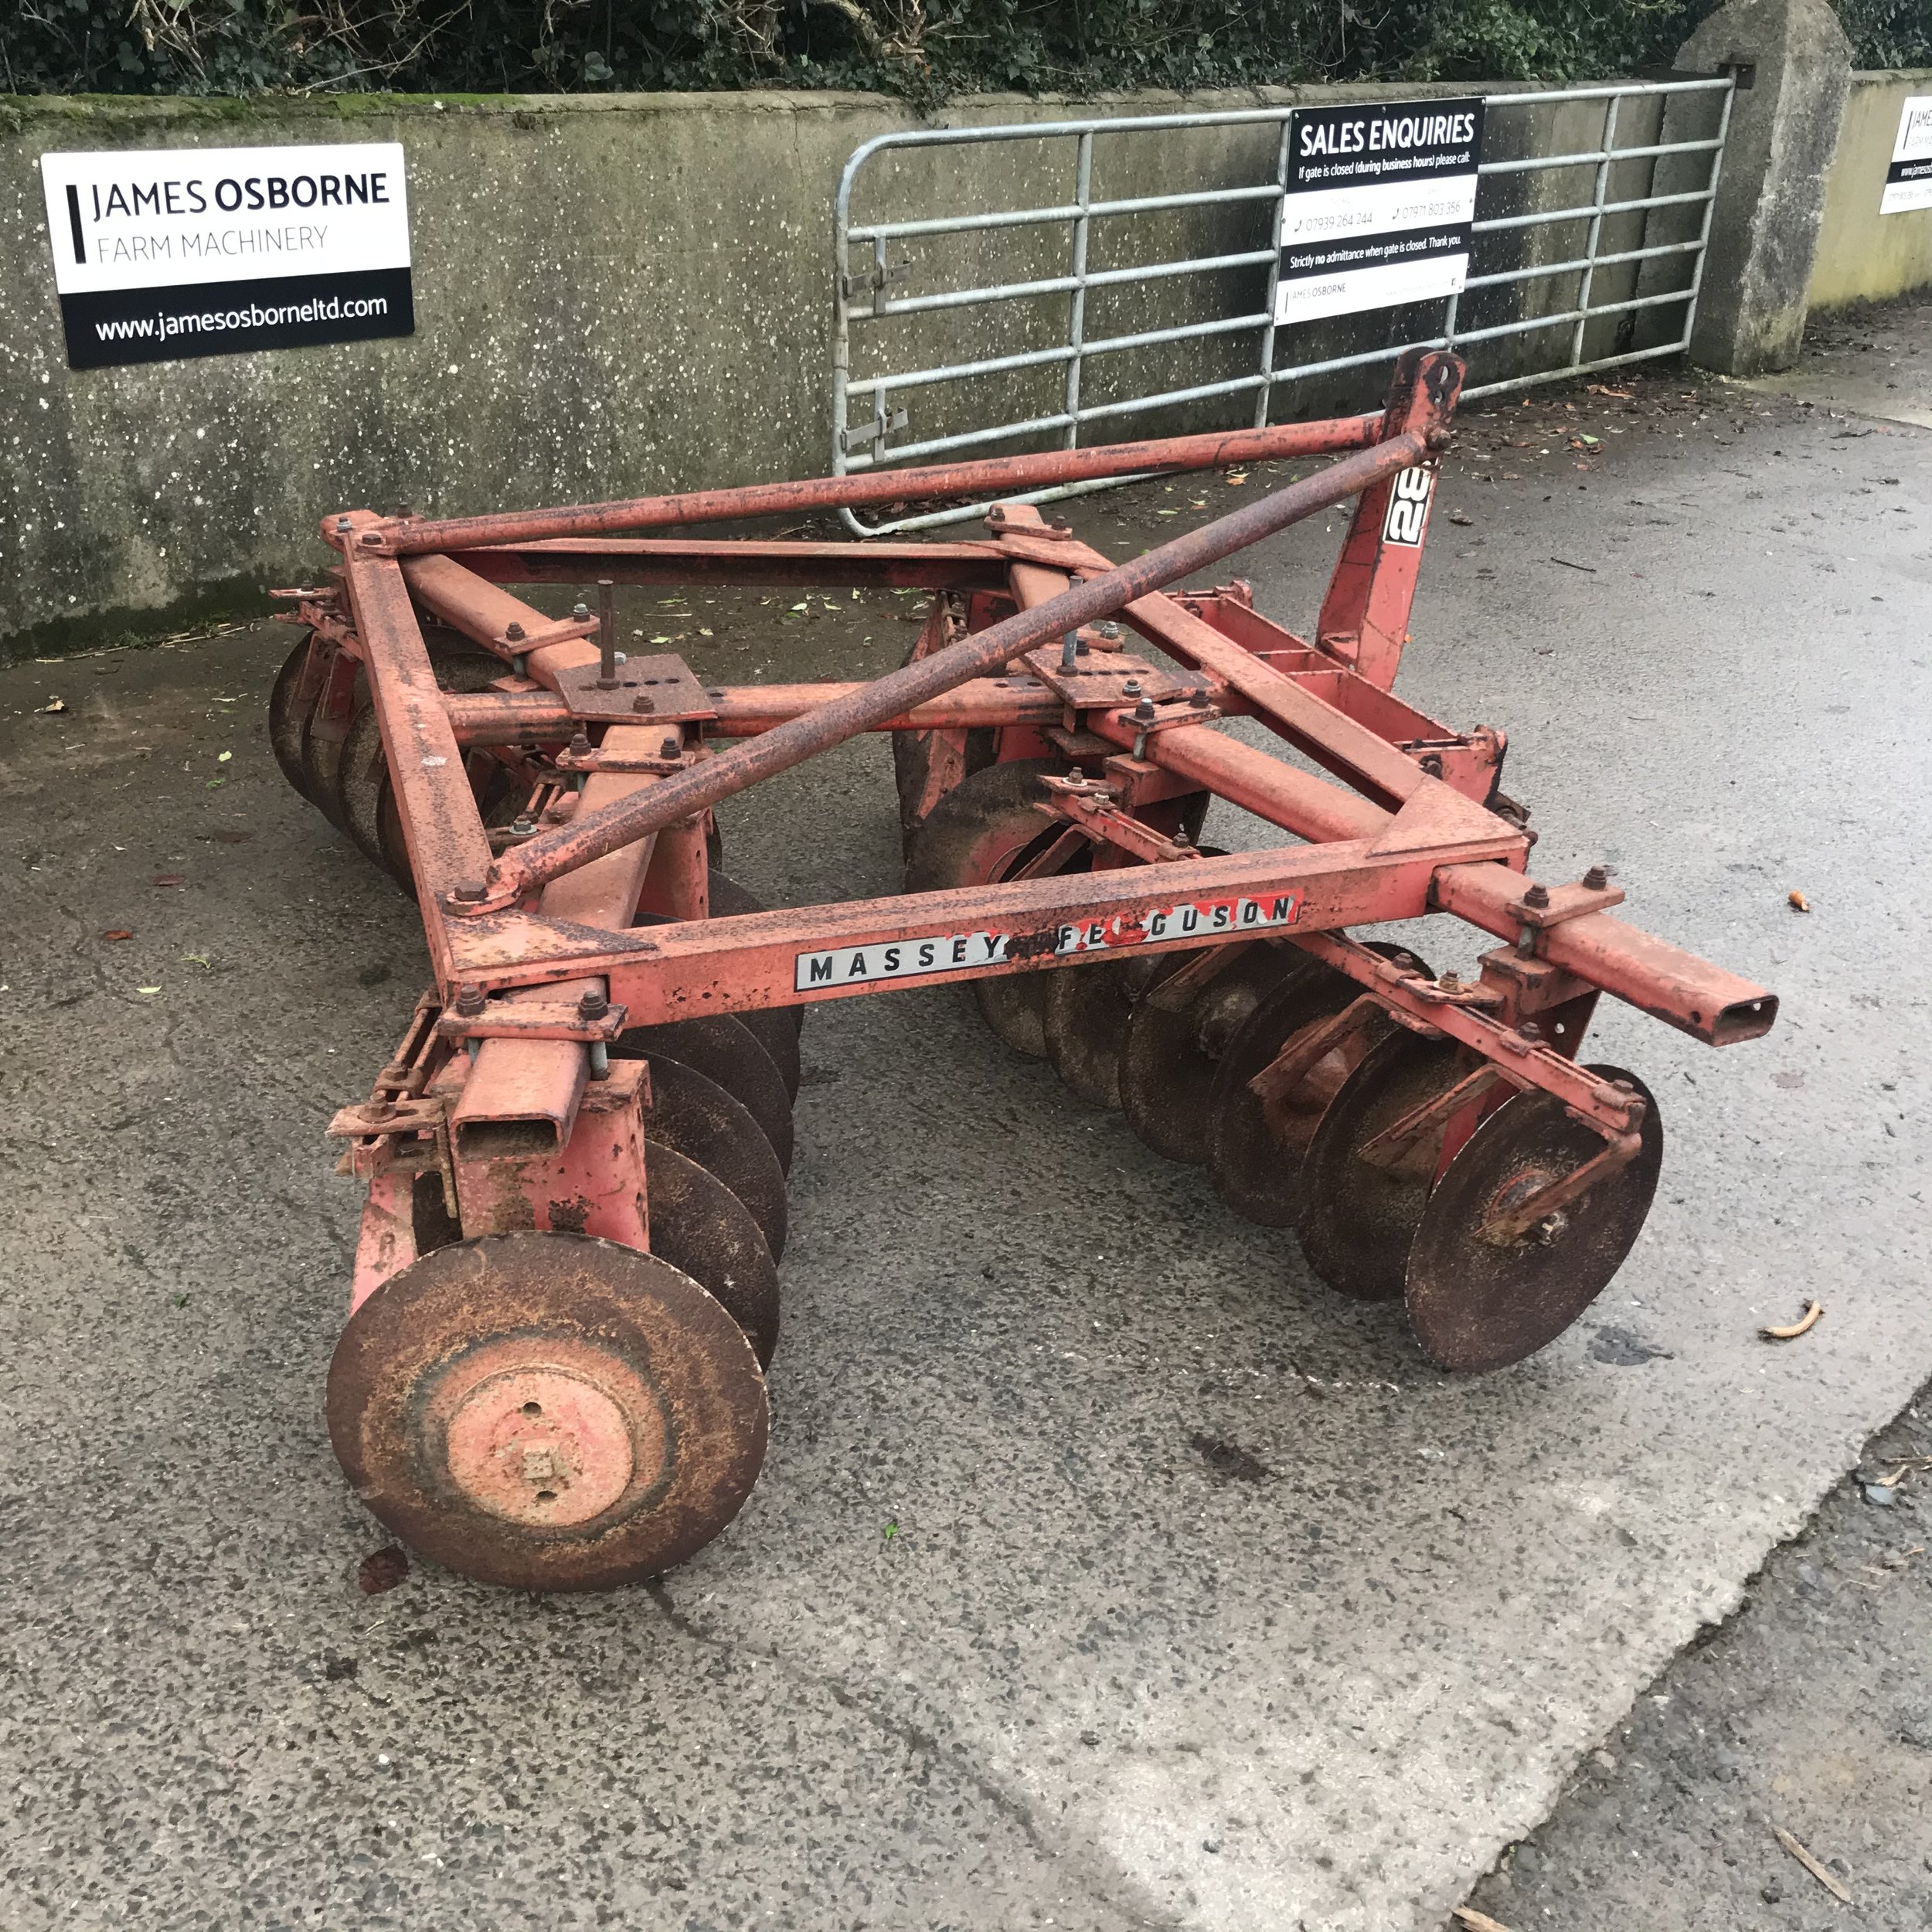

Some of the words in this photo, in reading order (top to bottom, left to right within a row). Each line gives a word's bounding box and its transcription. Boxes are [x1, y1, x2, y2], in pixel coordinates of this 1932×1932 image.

[1300, 121, 1366, 157] SALES
[1369, 113, 1475, 151] ENQUIRIES
[1911, 109, 1932, 130] JAME
[1298, 165, 1305, 179] If
[1305, 166, 1322, 182] gate
[1323, 164, 1329, 177] is
[1330, 161, 1355, 176] closed
[1355, 159, 1382, 175] (during
[1382, 158, 1413, 172] business
[1413, 155, 1435, 168] hours)
[1435, 153, 1457, 169] please
[92, 179, 207, 223] JAMES
[215, 172, 390, 213] OSBORNE
[1402, 205, 1427, 219] 07971
[1428, 202, 1444, 216] 803
[1447, 200, 1461, 214] 356
[1305, 216, 1335, 231] 07939
[1337, 214, 1354, 228] 264
[1356, 212, 1372, 225] 244
[97, 234, 172, 264] FARM
[182, 225, 328, 258] MACHINERY
[1290, 254, 1315, 269] Strictly
[1315, 254, 1325, 265] no
[1326, 250, 1364, 264] admittance
[1365, 245, 1383, 257] when
[1383, 243, 1399, 258] gate
[1400, 241, 1405, 253] is
[1406, 237, 1427, 252] closed.
[1429, 235, 1447, 248] Thank
[1447, 236, 1461, 248] you.
[1312, 283, 1346, 297] OSBORNE
[95, 296, 388, 342] www.jamesosborneltd.com
[1389, 460, 1432, 543] 28
[809, 934, 1003, 983] MASSEY
[1057, 896, 1290, 951] FEGUSON
